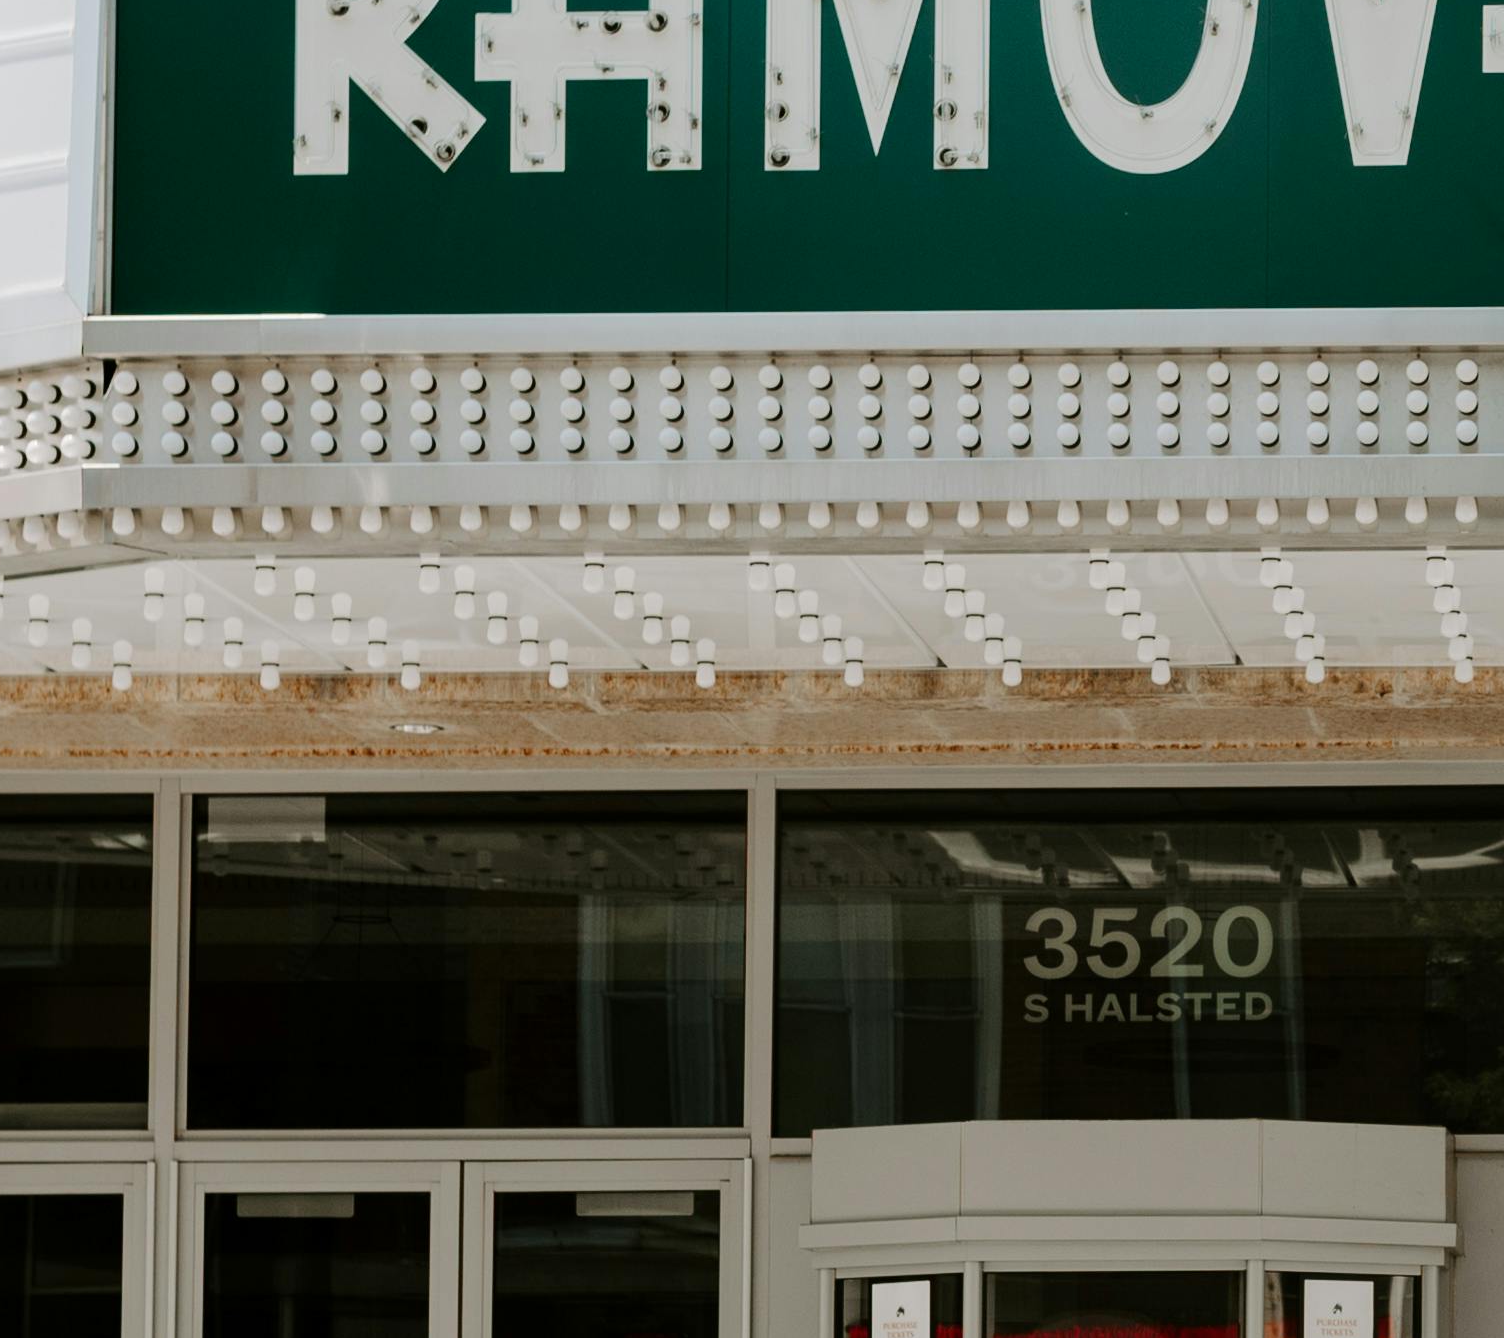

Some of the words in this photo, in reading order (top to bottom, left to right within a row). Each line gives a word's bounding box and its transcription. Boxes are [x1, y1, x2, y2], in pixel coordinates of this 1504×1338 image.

[1023, 904, 1274, 979] 3520
[1023, 993, 1050, 1023] S
[1065, 992, 1273, 1022] HALSTED
